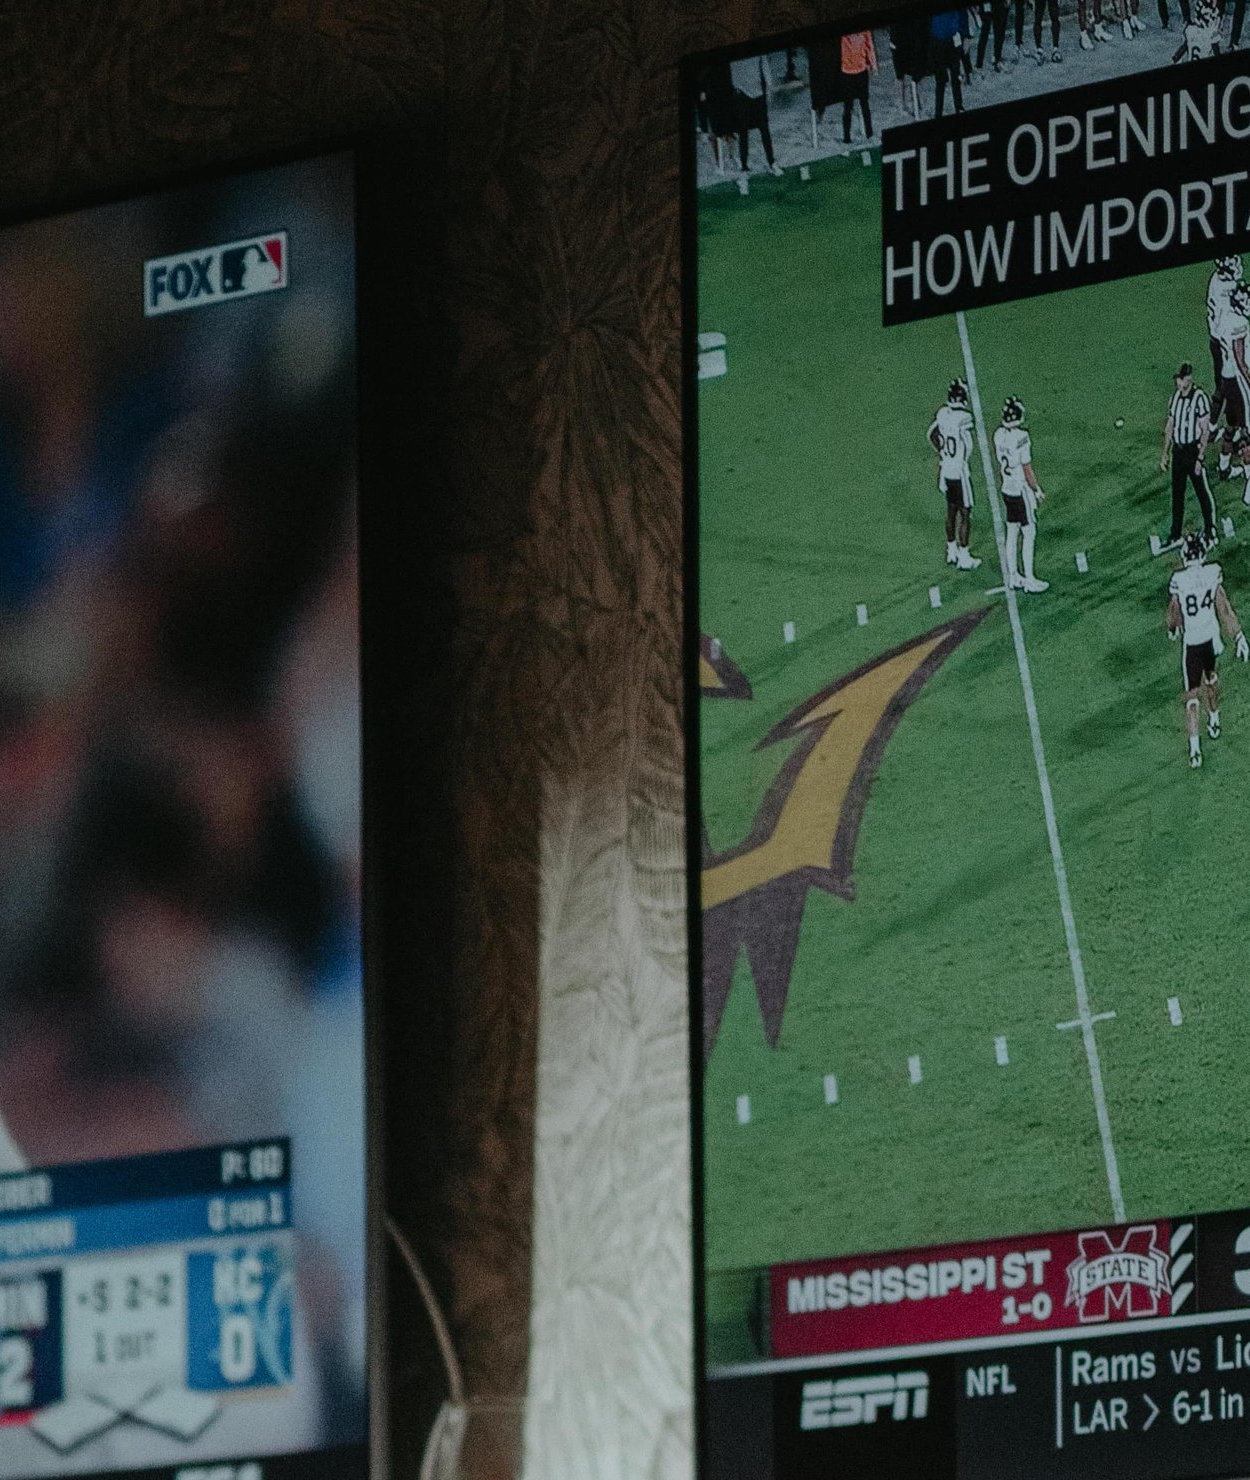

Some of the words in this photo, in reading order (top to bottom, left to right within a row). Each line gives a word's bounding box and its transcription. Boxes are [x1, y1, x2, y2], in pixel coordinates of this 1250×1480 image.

[882, 133, 991, 211] THE
[1007, 76, 1250, 185] OPENING
[885, 220, 1015, 306] HOW
[1033, 170, 1250, 274] IMPORT
[151, 255, 215, 307] FOX
[1186, 588, 1214, 616] 84
[786, 1255, 997, 1315] MISSISSIPPI
[1002, 1250, 1052, 1289] ST
[1085, 1257, 1150, 1287] STATE
[1001, 1293, 1053, 1325] 1-0
[217, 1314, 256, 1383] 0
[1071, 1350, 1157, 1387] Rams
[1170, 1347, 1202, 1375] vs
[799, 1370, 931, 1432] ESPN
[966, 1365, 1017, 1397] NFL
[1073, 1397, 1129, 1435] LAR
[1173, 1387, 1214, 1425] 6-1
[1219, 1386, 1245, 1420] in
